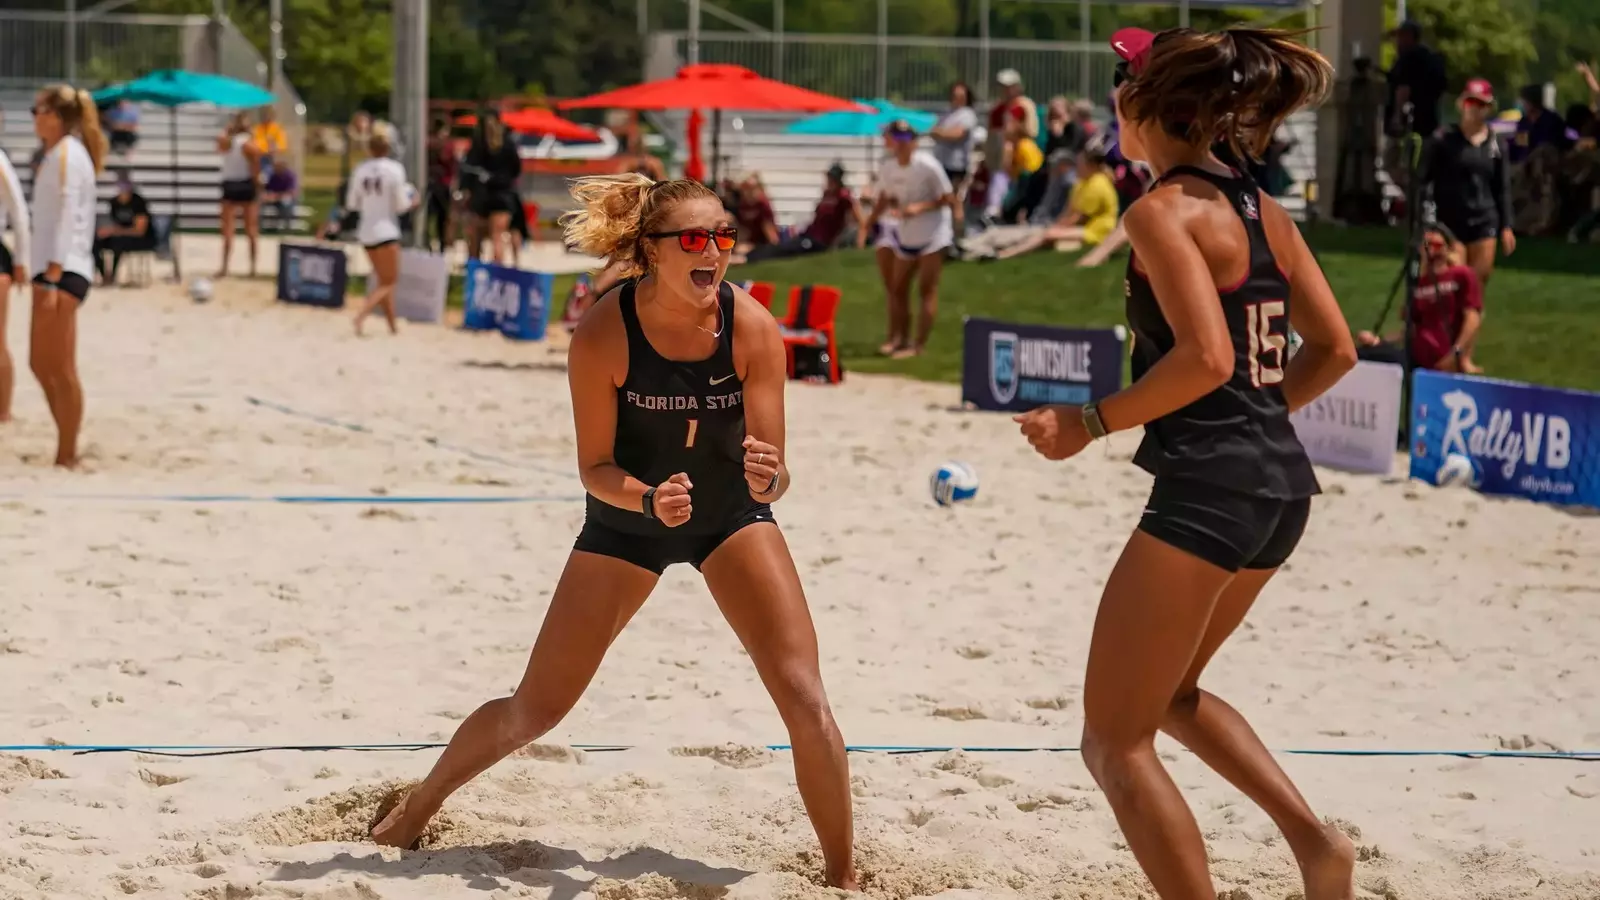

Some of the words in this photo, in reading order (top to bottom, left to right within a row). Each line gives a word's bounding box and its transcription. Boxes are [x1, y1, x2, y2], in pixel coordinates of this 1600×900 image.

[1019, 338, 1092, 382] HUNTSVILLE
[1245, 300, 1286, 388] 15
[626, 390, 699, 410] FLORIDA
[704, 390, 743, 410] STAT
[1297, 395, 1378, 432] TSVILLE
[684, 418, 699, 448] 1
